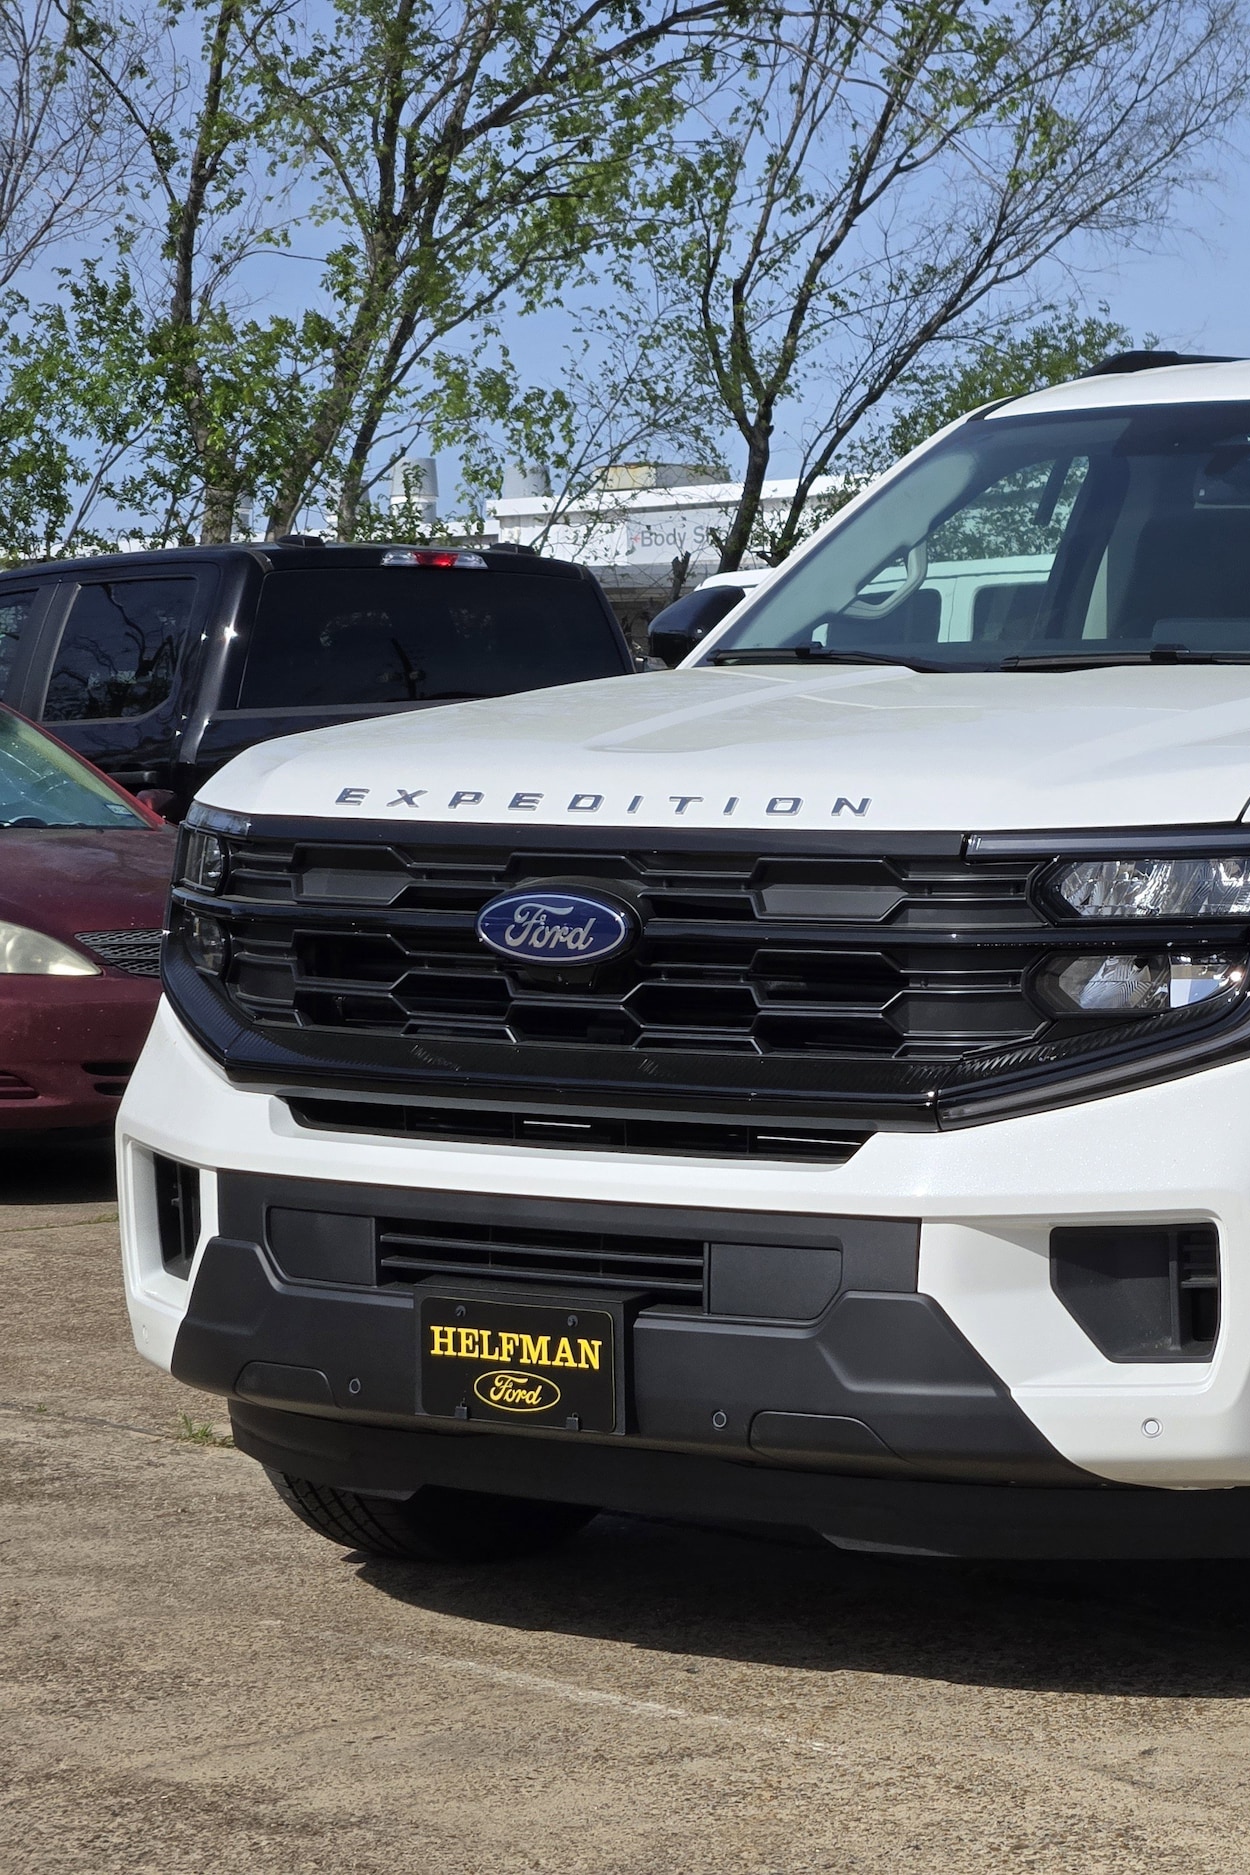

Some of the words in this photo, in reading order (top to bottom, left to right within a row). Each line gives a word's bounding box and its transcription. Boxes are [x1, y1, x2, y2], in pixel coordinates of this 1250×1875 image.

[640, 528, 687, 549] Body
[334, 787, 873, 818] EXPEDITION
[504, 902, 597, 951] Ford
[429, 1325, 603, 1370] HELFMAN
[489, 1374, 543, 1406] Ford
